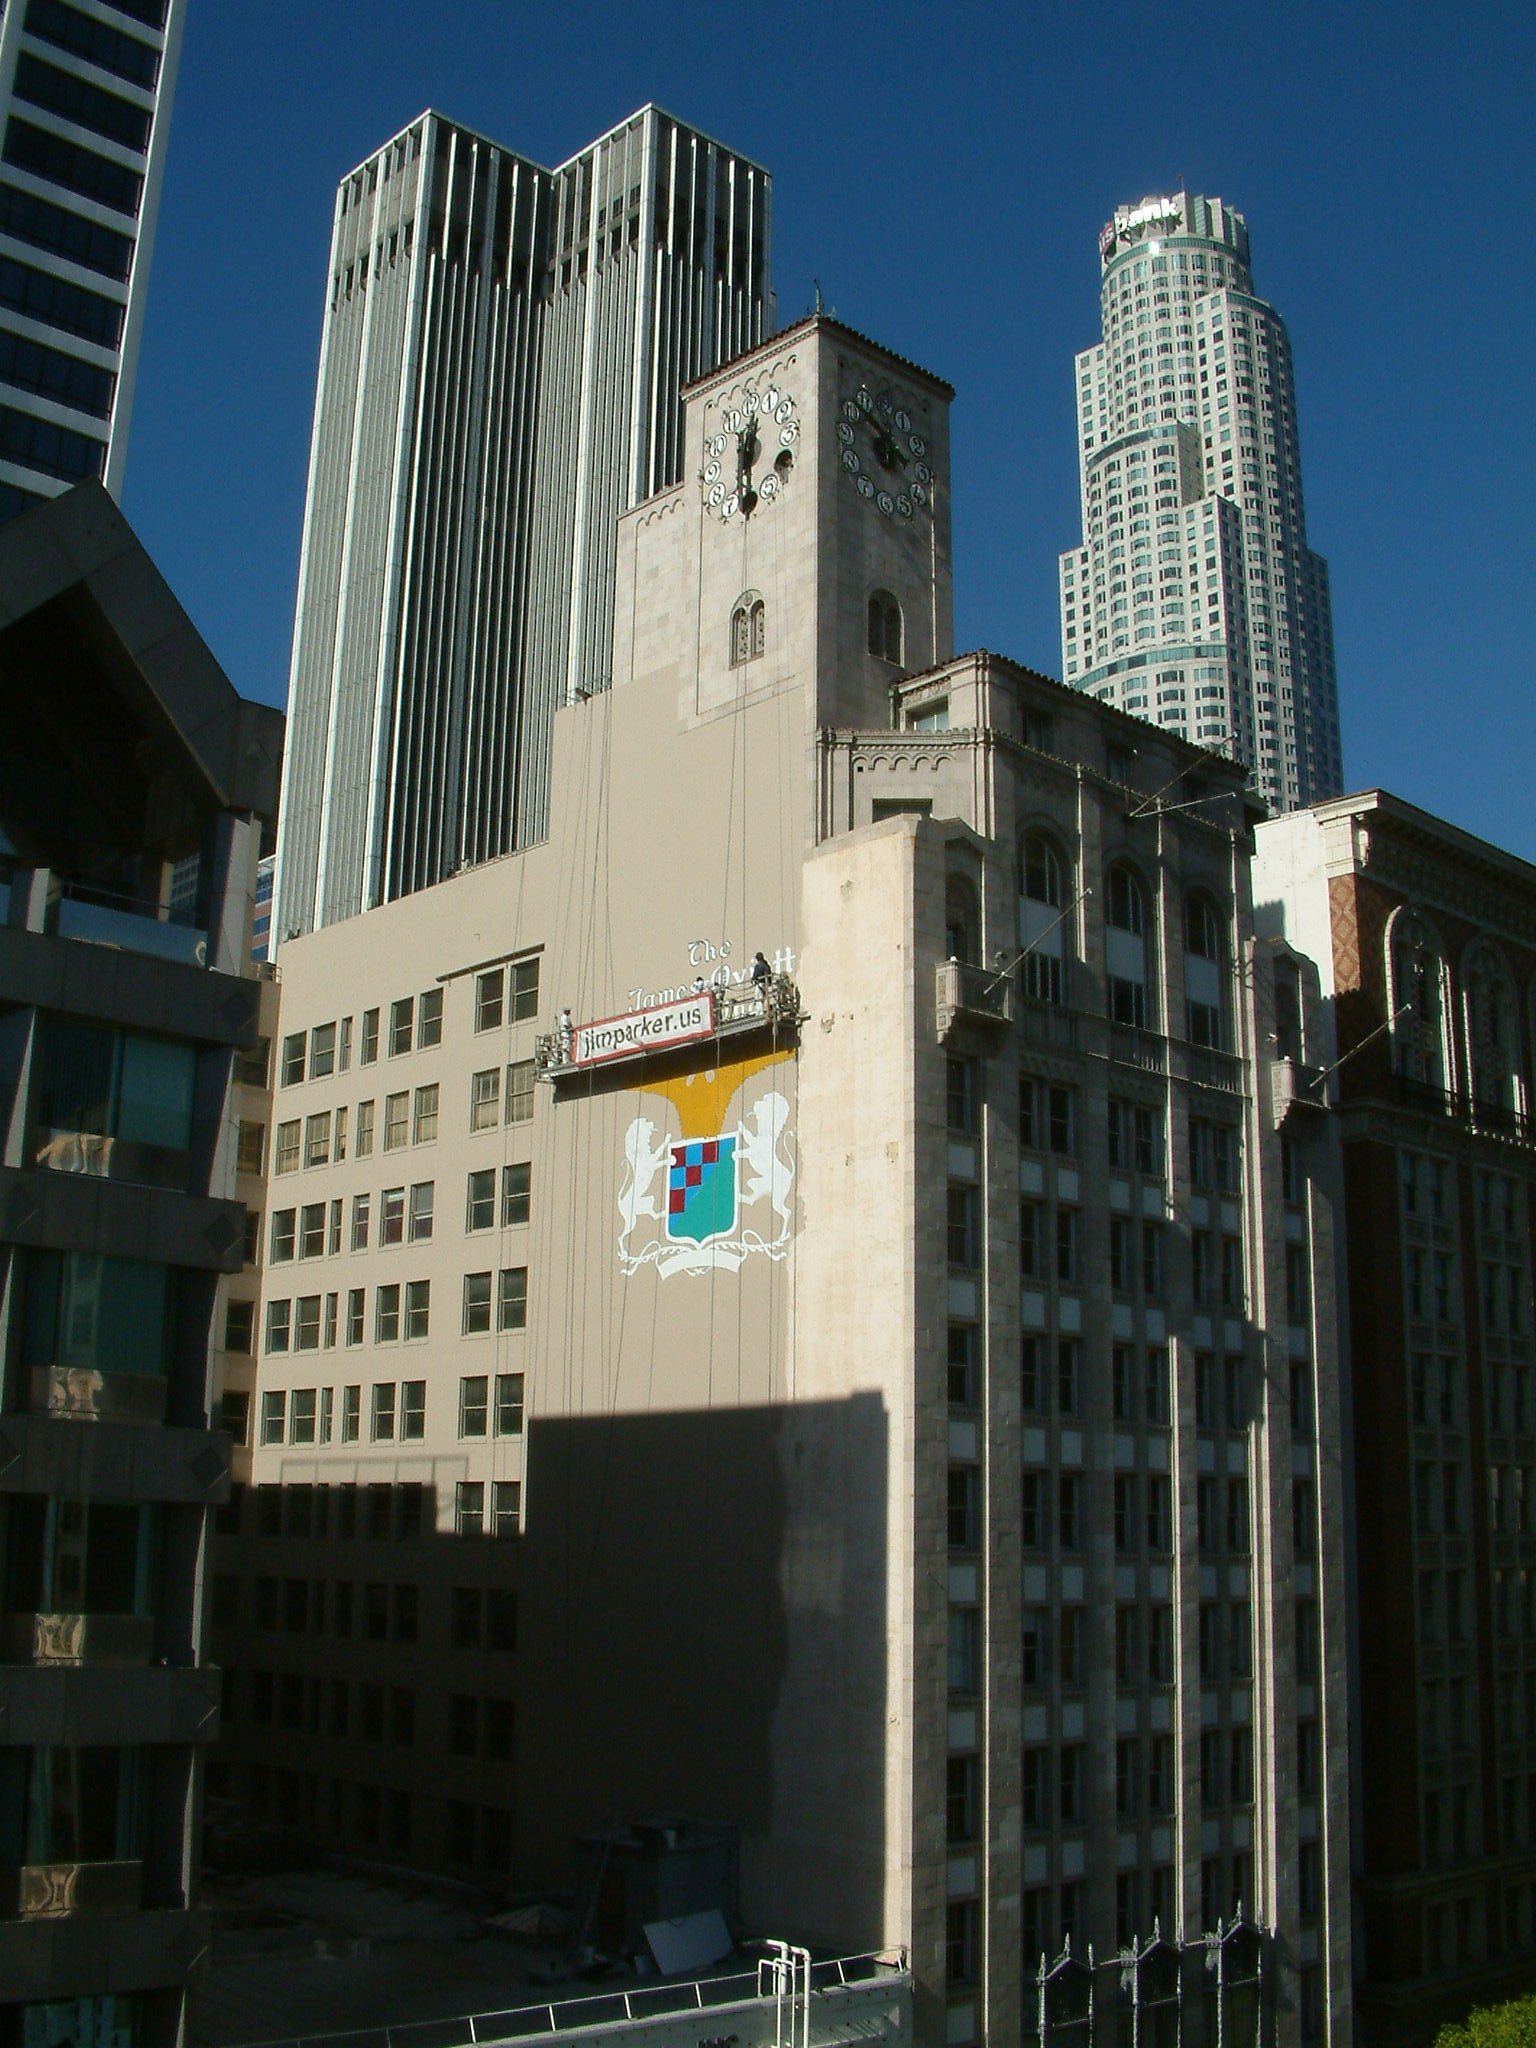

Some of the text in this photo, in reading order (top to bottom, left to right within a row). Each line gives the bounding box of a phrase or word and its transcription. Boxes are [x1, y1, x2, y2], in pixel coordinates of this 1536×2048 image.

[687, 938, 732, 967] The
[628, 980, 702, 1013] James
[583, 1006, 701, 1058] jimparker.us
